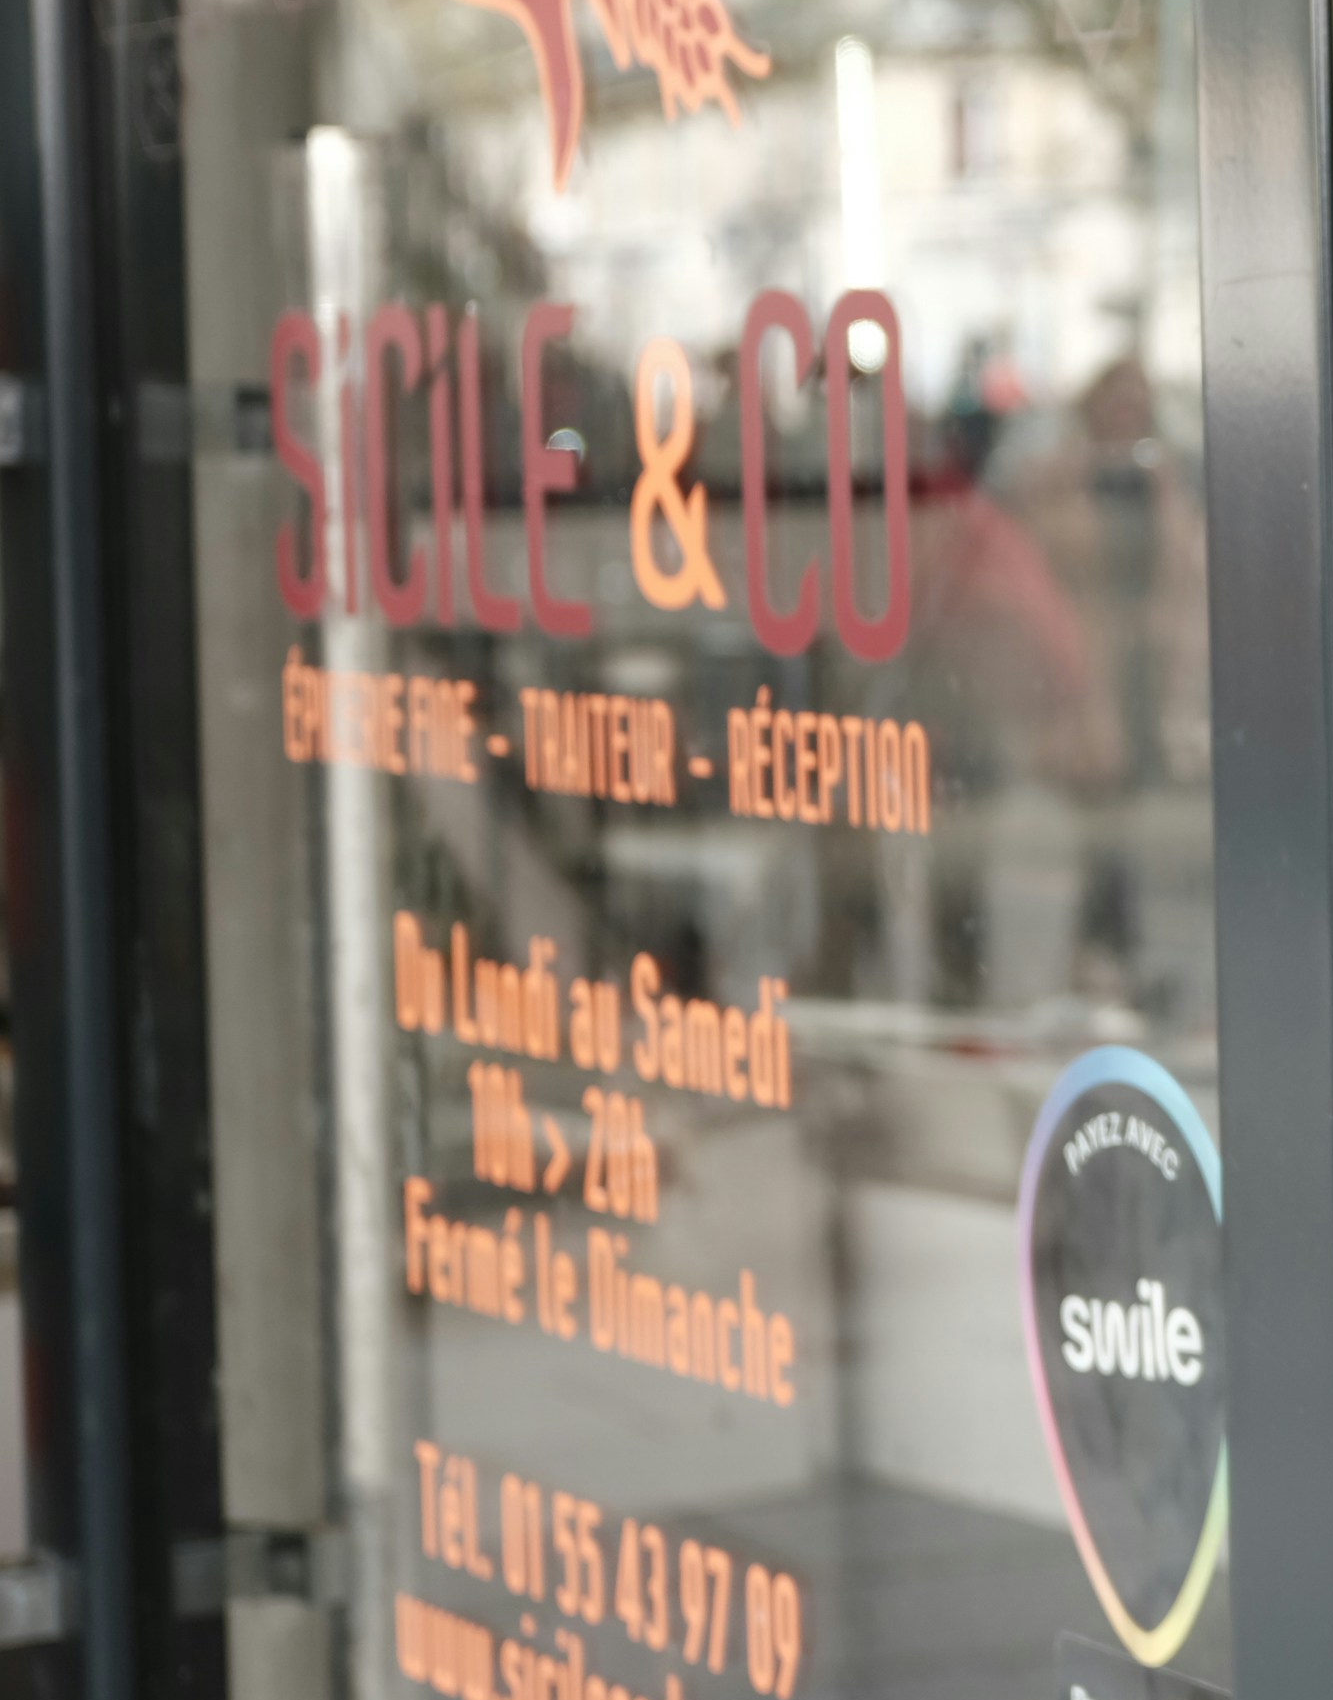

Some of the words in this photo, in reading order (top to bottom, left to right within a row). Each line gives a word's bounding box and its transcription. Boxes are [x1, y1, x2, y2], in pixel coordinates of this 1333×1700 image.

[630, 336, 726, 610] &
[740, 289, 909, 662] CO
[519, 687, 678, 807] TRAITEUR
[727, 684, 931, 836] RÉCEPTION
[630, 951, 791, 1111] Samedi
[1063, 1111, 1122, 1178] PAYEZ
[1123, 1115, 1180, 1182] AVEC
[404, 1175, 525, 1325] Fermé
[533, 1210, 578, 1342] le
[587, 1226, 795, 1408] Dimanche
[1060, 1277, 1204, 1386] swile
[552, 1489, 606, 1626] 55
[614, 1517, 669, 1653] 43
[679, 1539, 732, 1674] 97
